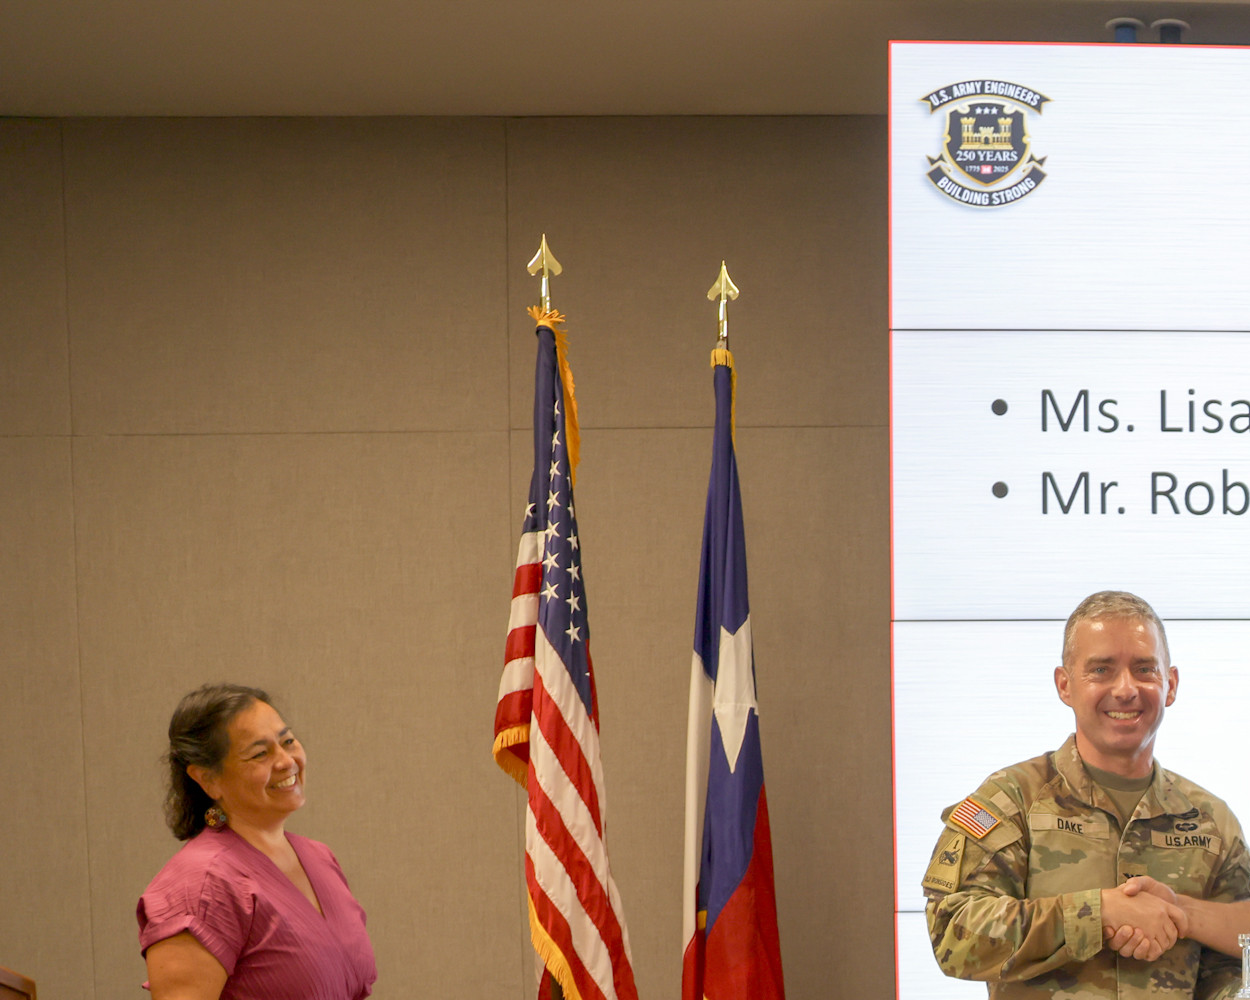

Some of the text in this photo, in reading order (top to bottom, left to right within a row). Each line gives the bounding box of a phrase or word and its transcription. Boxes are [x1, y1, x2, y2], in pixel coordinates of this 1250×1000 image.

[929, 80, 1041, 107] U.S. ARMY ENGINEERS
[956, 150, 1019, 162] 250 YEARS
[936, 177, 1036, 206] BUILDING STRONG
[1041, 389, 1135, 434] Ms.
[1041, 471, 1126, 515] Mr.
[1056, 818, 1083, 834] DAKE
